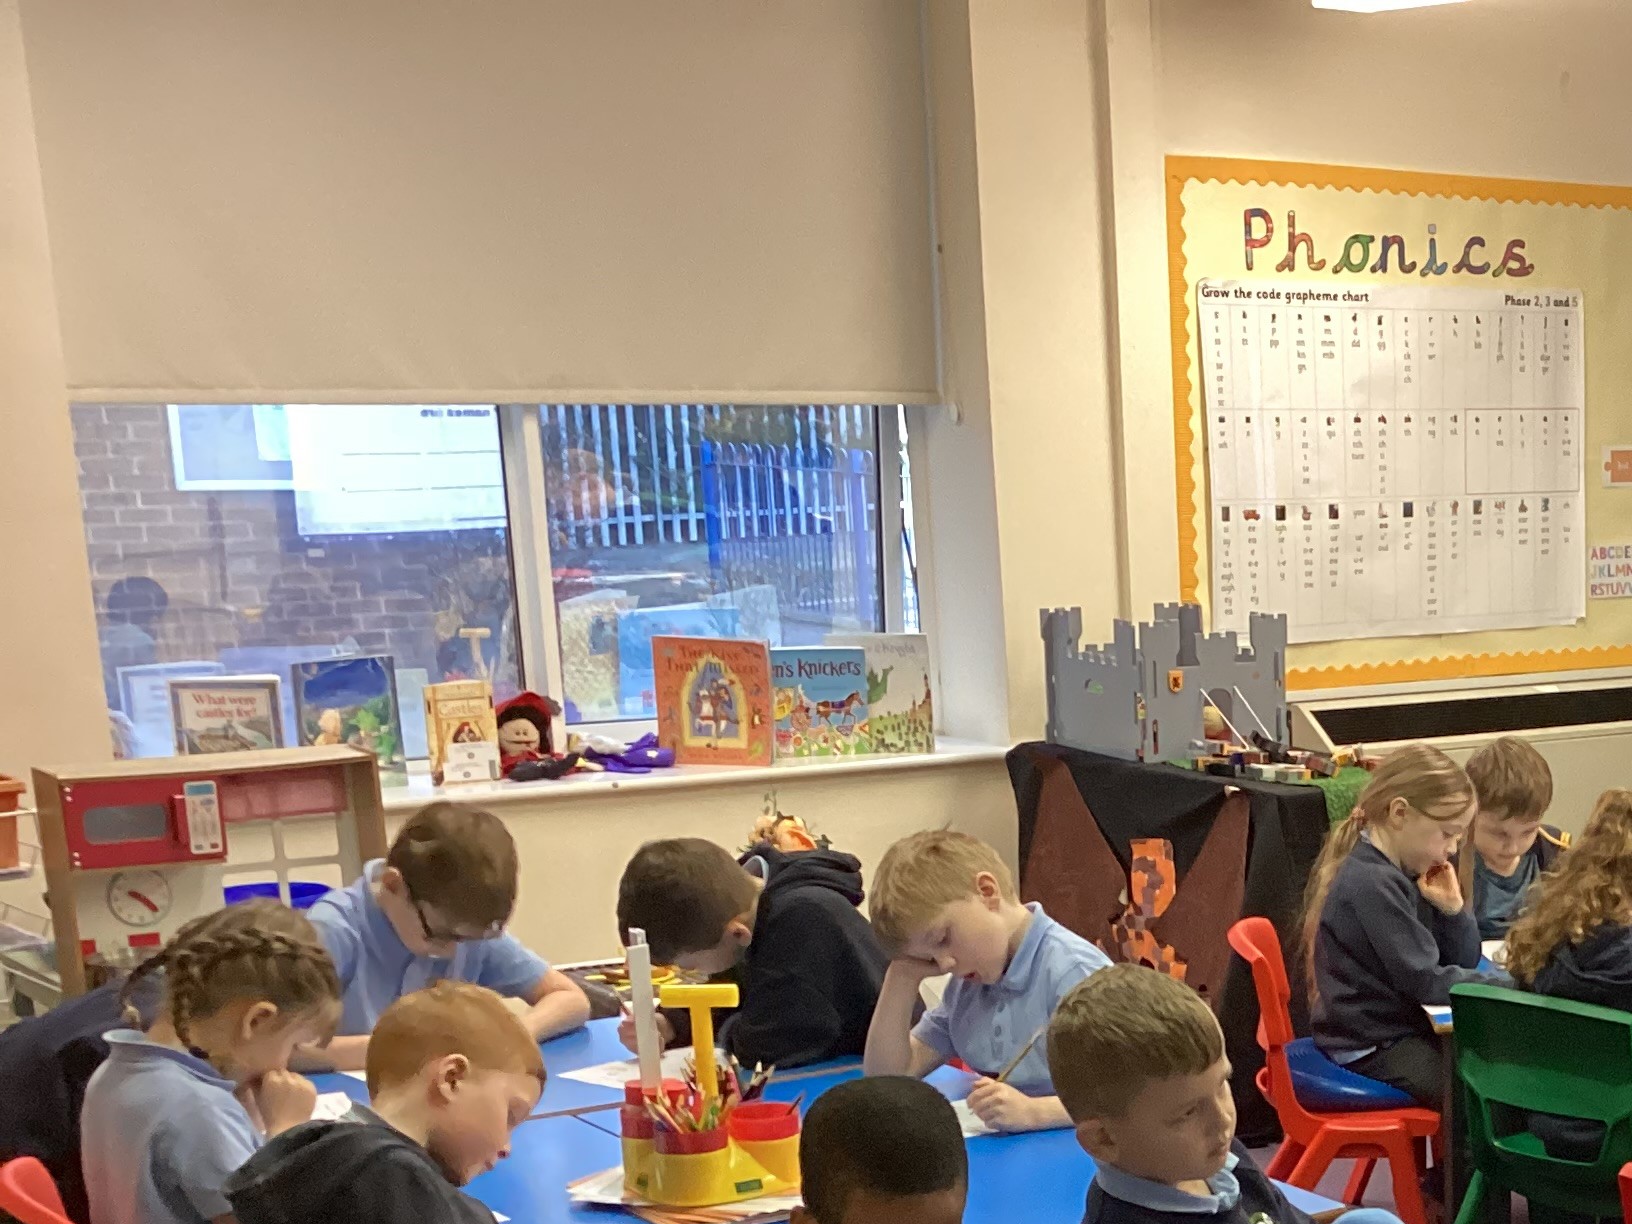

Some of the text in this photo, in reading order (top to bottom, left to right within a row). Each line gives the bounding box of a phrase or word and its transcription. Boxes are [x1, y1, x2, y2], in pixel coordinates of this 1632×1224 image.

[1244, 207, 1535, 278] Phonics
[1201, 286, 1369, 304] Grow the code grapheme chart
[1505, 295, 1531, 307] Phase
[1545, 296, 1551, 307] 3
[1554, 297, 1570, 307] and
[1572, 297, 1578, 308] 5
[797, 658, 861, 679] Knickers
[192, 692, 257, 704] What were
